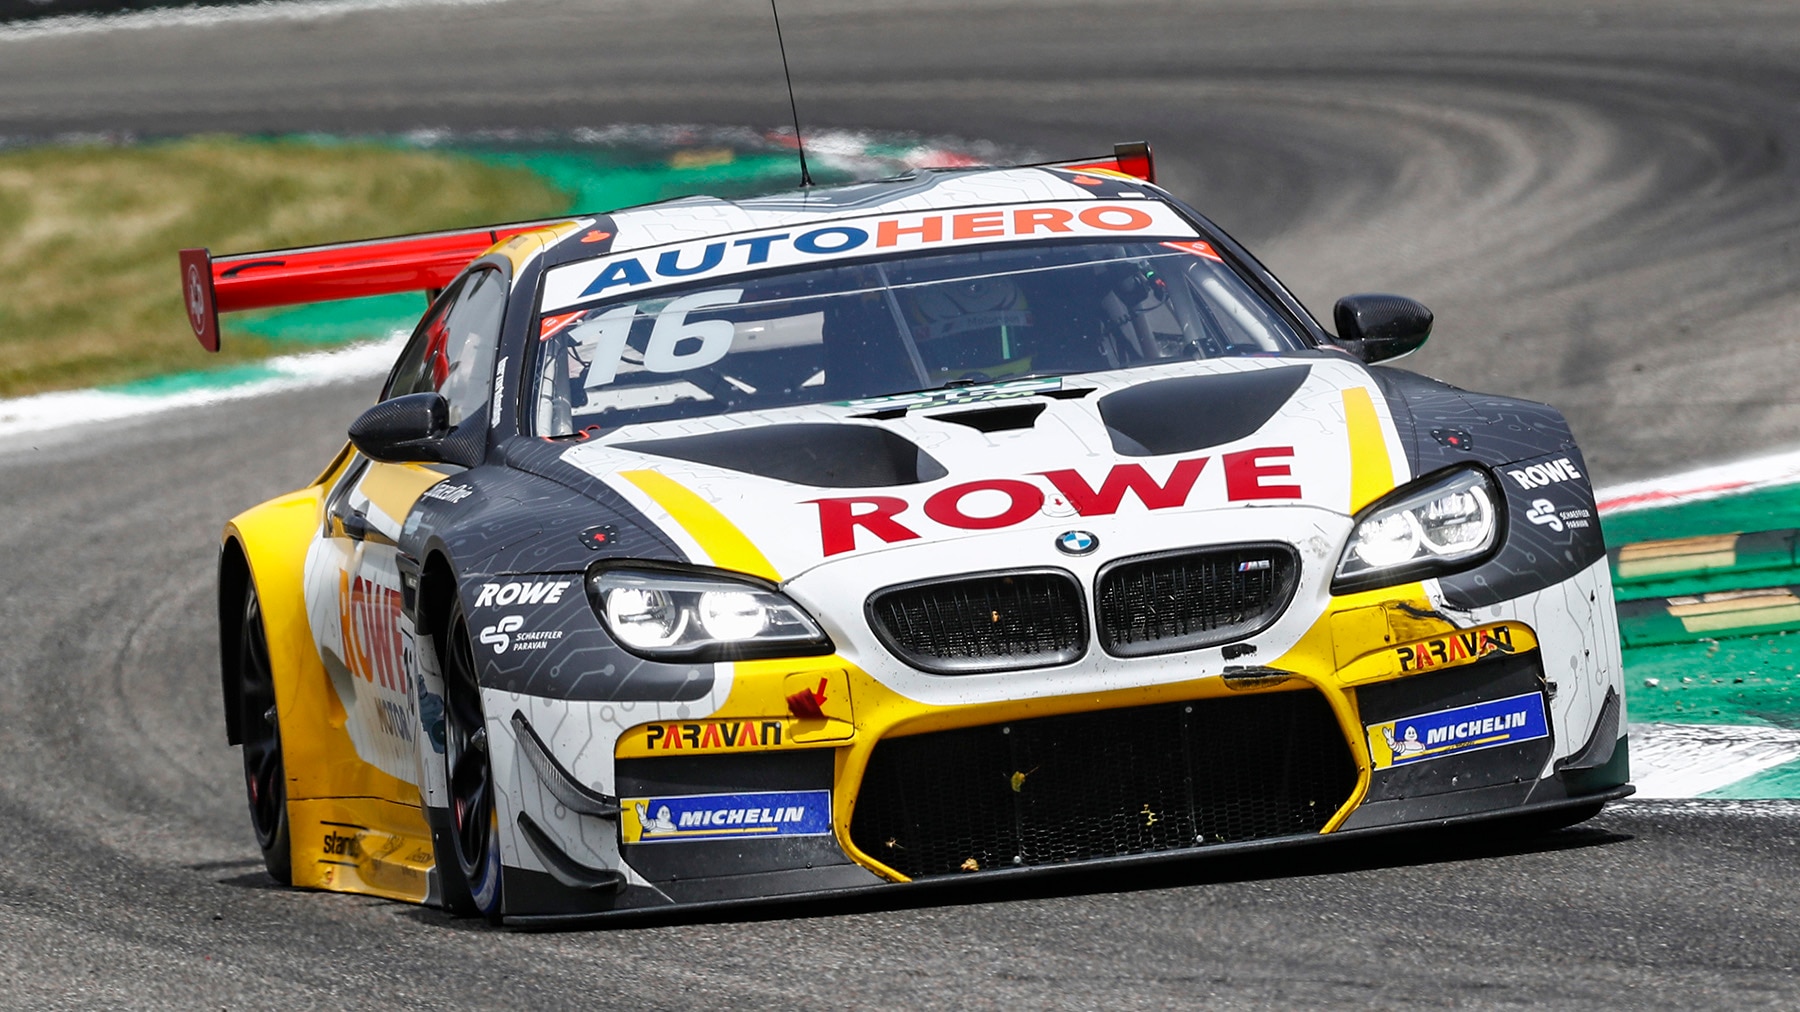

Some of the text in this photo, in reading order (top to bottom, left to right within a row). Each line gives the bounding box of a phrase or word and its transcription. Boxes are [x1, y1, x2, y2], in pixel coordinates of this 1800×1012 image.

[577, 205, 1153, 298] AUTOHERO
[567, 288, 744, 389] 16
[1507, 458, 1581, 490] ROWE
[796, 446, 1302, 557] ROWE
[474, 581, 571, 607] ROWE
[339, 568, 407, 695] ROWE
[513, 641, 548, 651] PARAVAN
[516, 631, 563, 642] SCHAEFFLER
[1396, 626, 1514, 671] PARAVAN
[647, 721, 782, 749] PARAVAN
[1426, 711, 1527, 744] MICHELIN
[678, 806, 805, 828] MICHELIN
